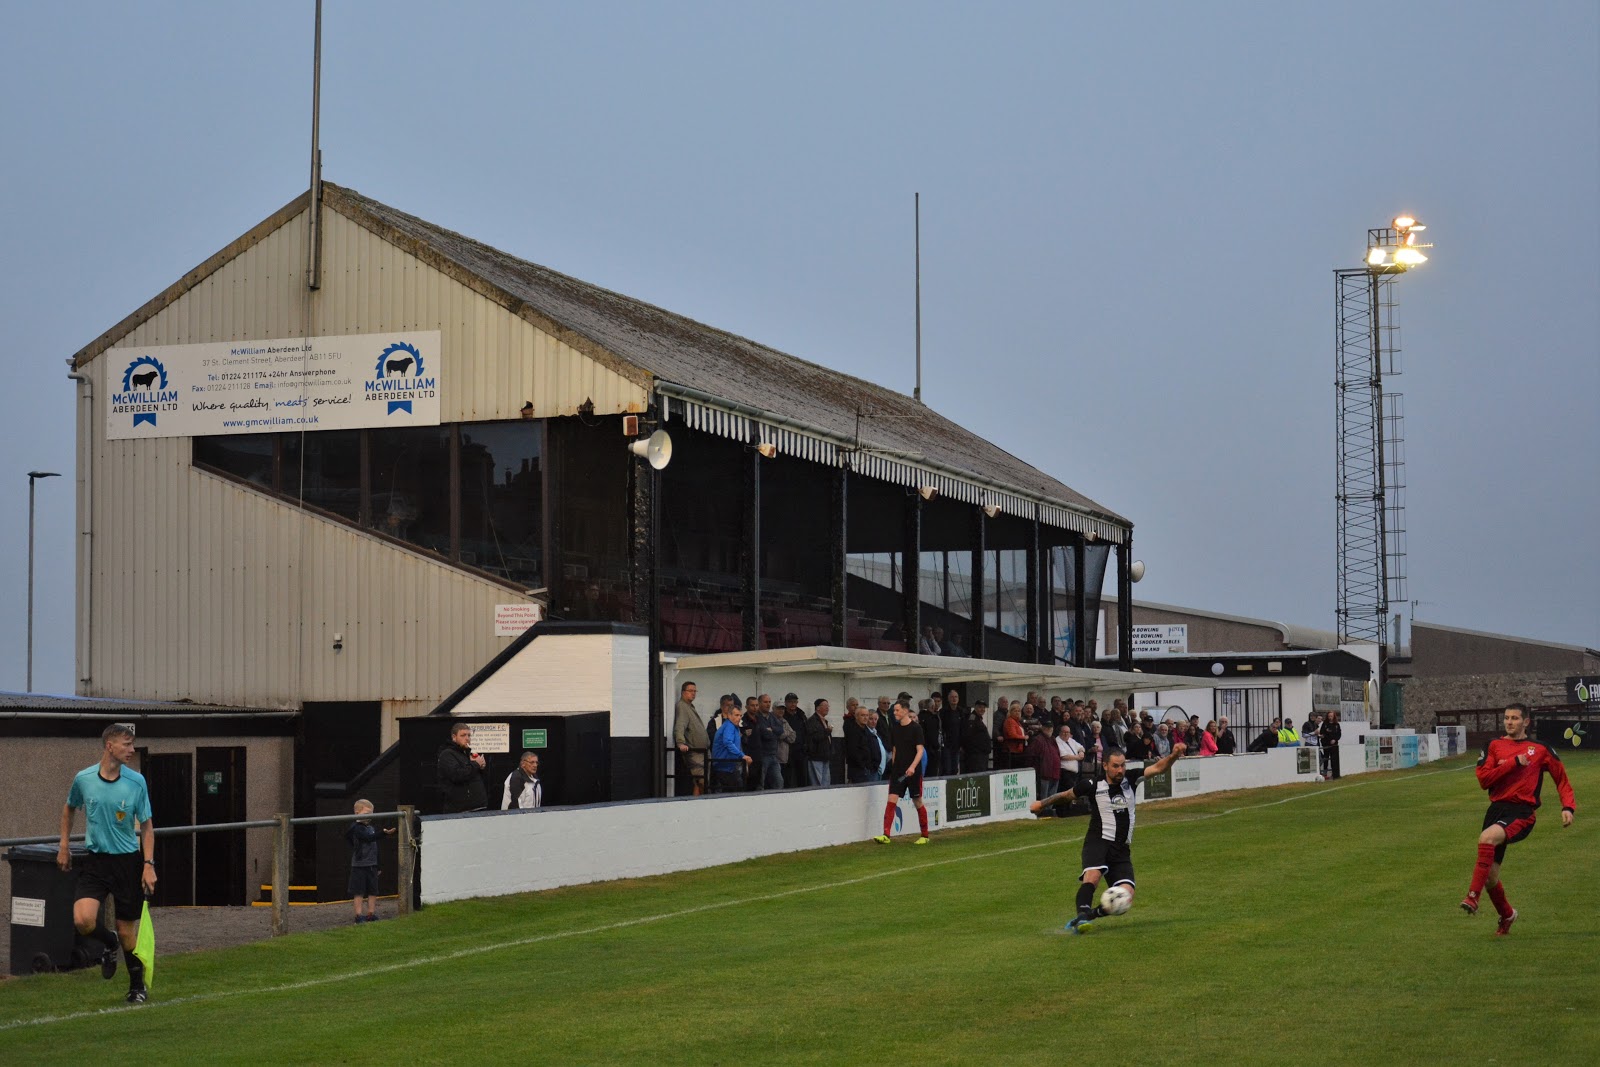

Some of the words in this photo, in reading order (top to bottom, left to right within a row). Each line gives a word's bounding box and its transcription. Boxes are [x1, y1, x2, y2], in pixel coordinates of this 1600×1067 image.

[231, 348, 266, 356] McWilliam
[267, 346, 300, 354] Aberdeen
[301, 344, 313, 352] Ltd
[202, 359, 211, 367] 37
[222, 358, 250, 366] Clement
[309, 353, 326, 361] AB11
[328, 352, 342, 360] 5FU
[221, 373, 242, 381] 01224
[242, 371, 267, 380] 211174
[268, 370, 288, 378] +24hr
[289, 369, 336, 377] Answerphone
[207, 384, 227, 392] 01224
[227, 382, 251, 390] 211128
[254, 381, 276, 390] Email:
[277, 378, 352, 388] info@gmcwilliam.co.uk
[365, 378, 435, 392] McWILLIAM
[112, 391, 178, 404] McWILLIAM
[365, 391, 415, 401] ABERDEEN
[418, 390, 435, 399] LTD
[112, 404, 159, 413] ABERDEEN
[162, 403, 178, 411] LTD
[192, 401, 226, 411] Where
[229, 397, 269, 412] quality
[313, 393, 352, 407] service!
[222, 415, 319, 428] www.gmcwilliam.co.uk
